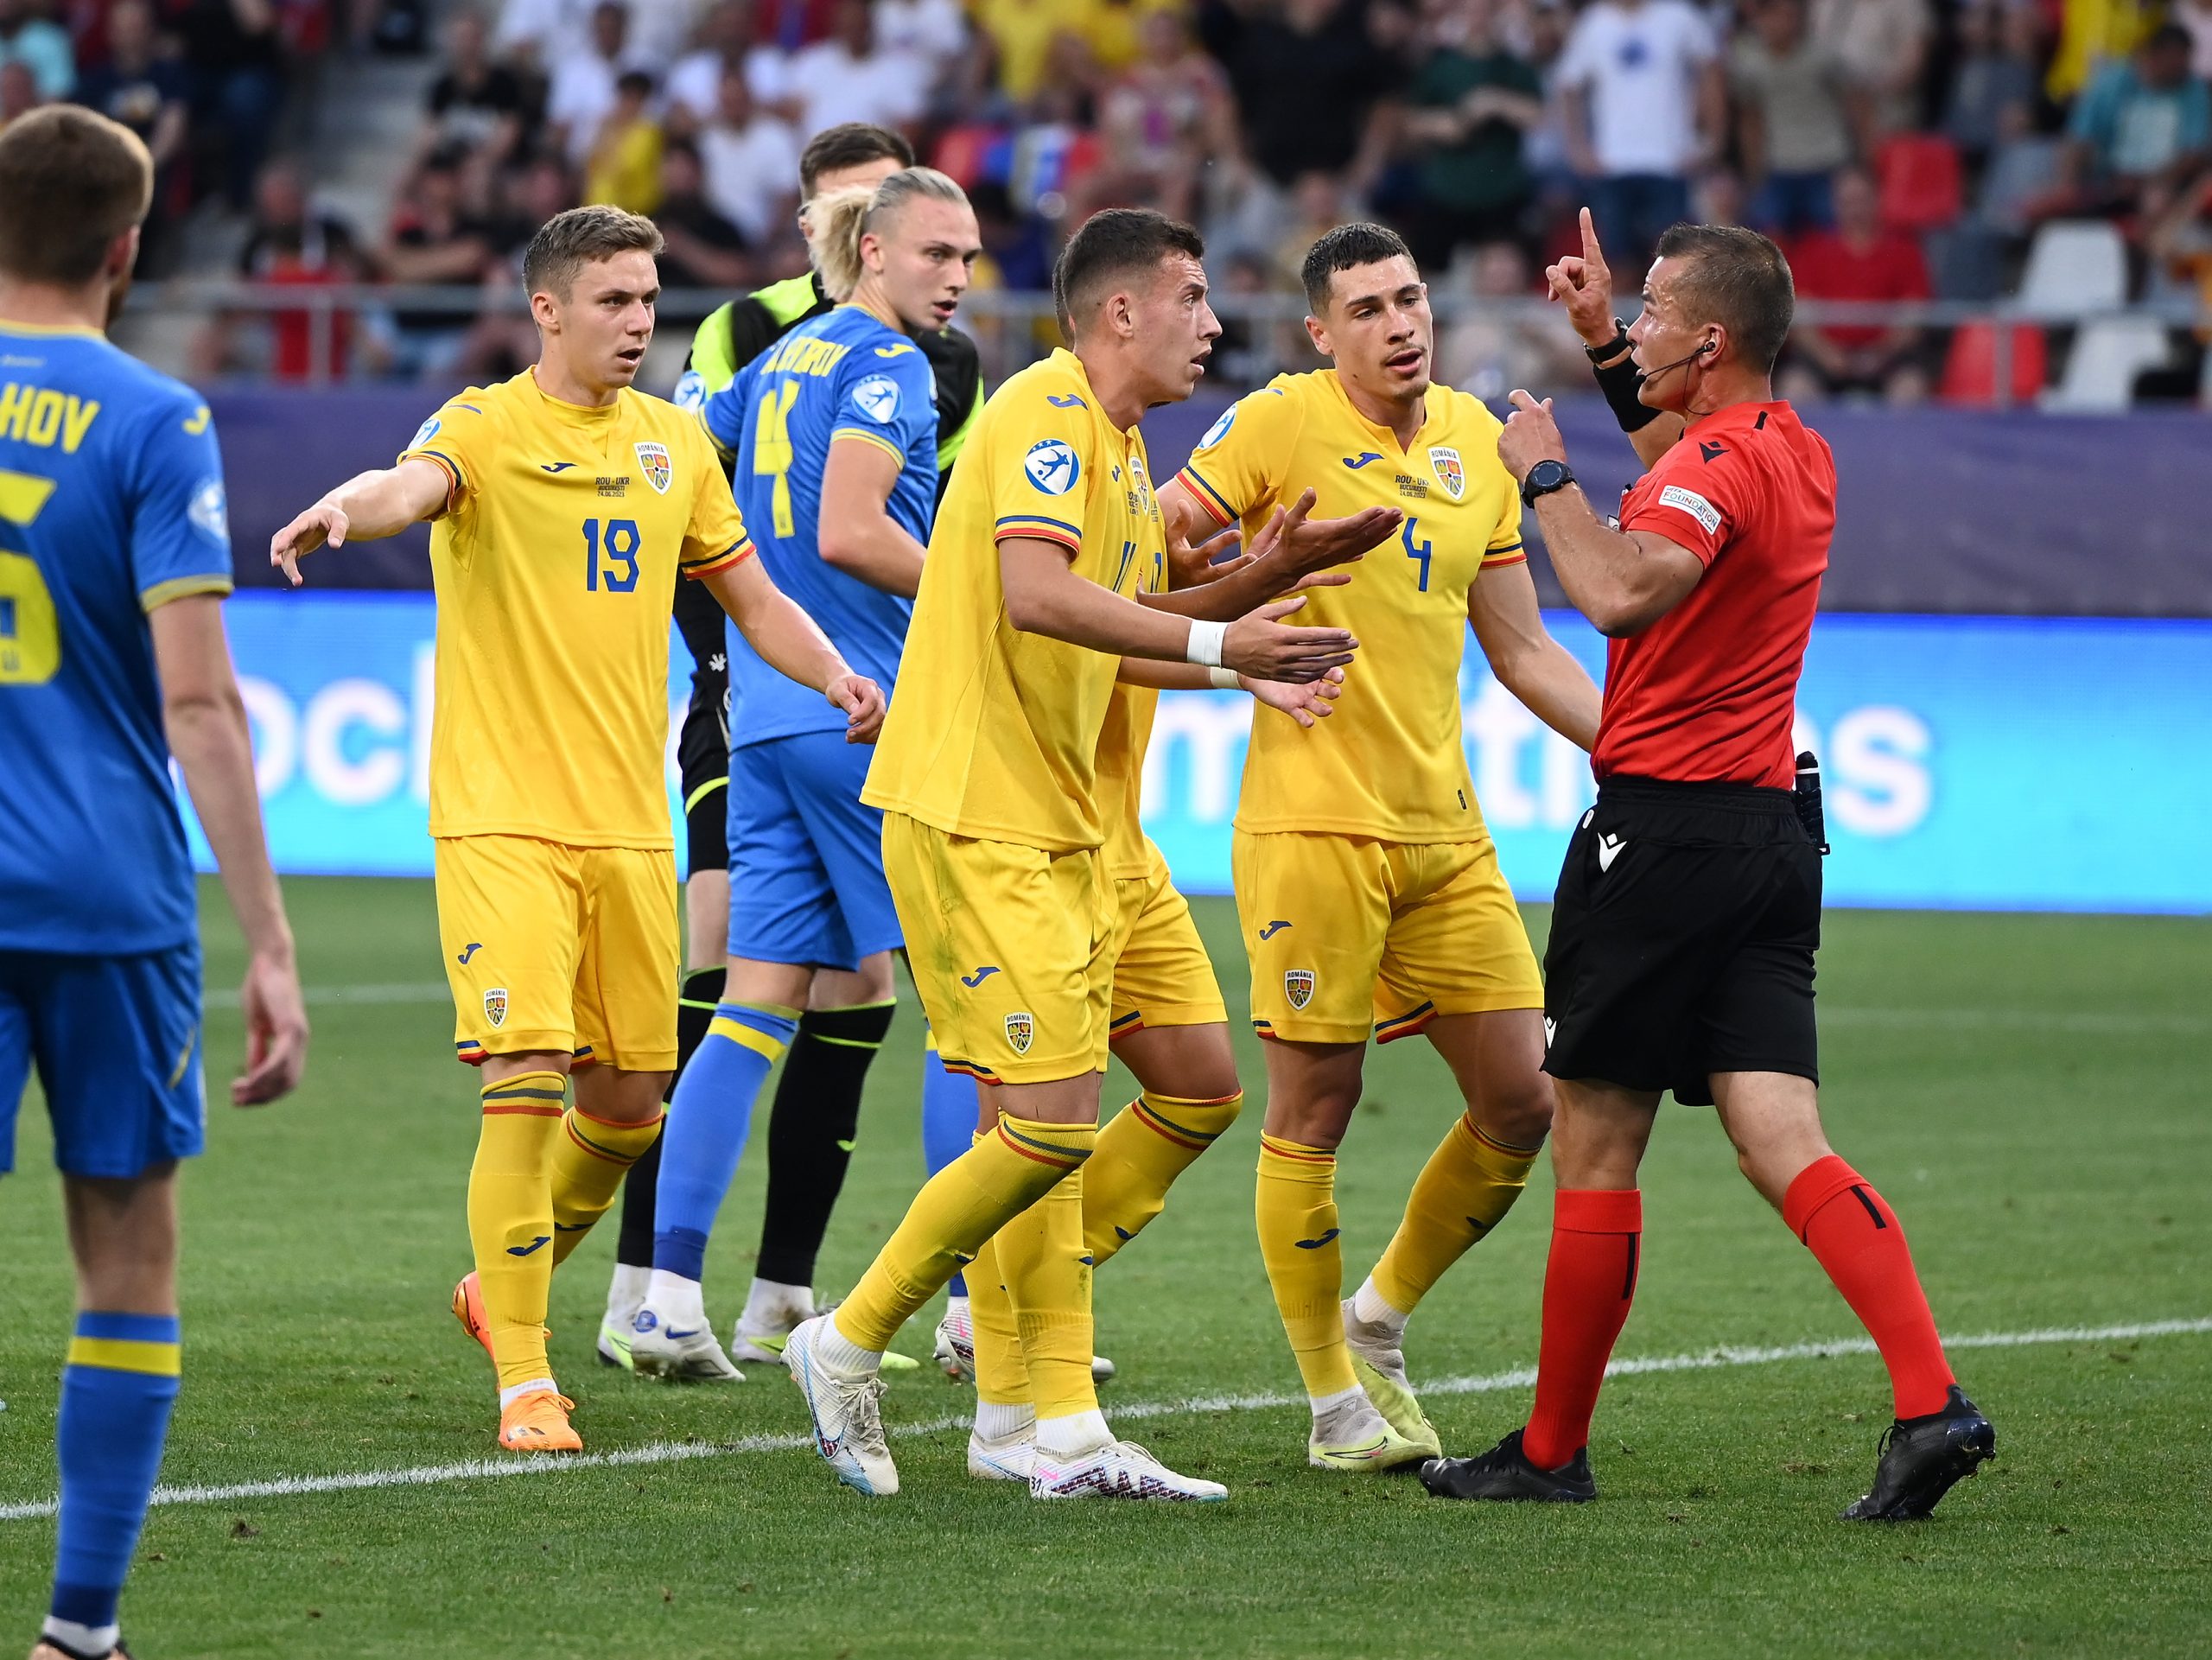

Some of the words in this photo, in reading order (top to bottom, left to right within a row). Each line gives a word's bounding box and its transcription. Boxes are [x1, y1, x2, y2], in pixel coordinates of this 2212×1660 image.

[0, 383, 101, 454] HOV
[595, 477, 611, 486] ROU
[615, 477, 630, 486] UKR
[1395, 474, 1412, 485] ROU
[1663, 491, 1719, 528] FOUNDATION
[582, 518, 641, 592] 19
[1402, 517, 1432, 593] 4
[1031, 1476, 1042, 1492] 31
